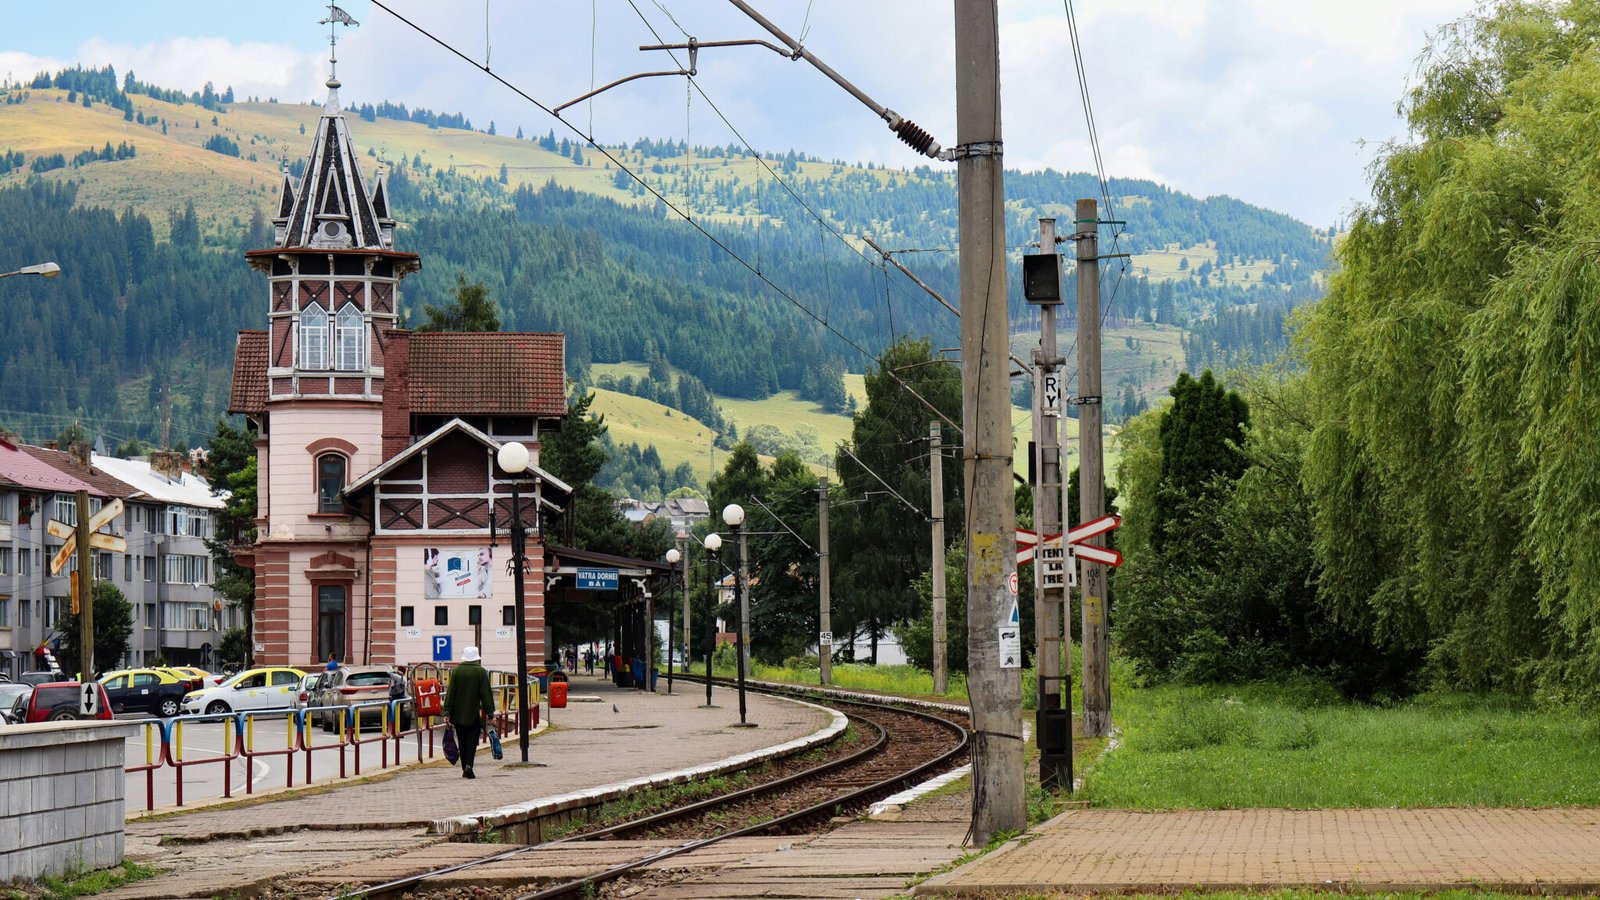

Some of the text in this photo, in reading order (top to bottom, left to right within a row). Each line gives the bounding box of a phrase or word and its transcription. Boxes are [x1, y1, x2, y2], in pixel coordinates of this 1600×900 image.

[1049, 563, 1062, 571] LA
[597, 572, 618, 580] DORNEI
[1043, 573, 1072, 584] TRE
[436, 638, 447, 654] P
